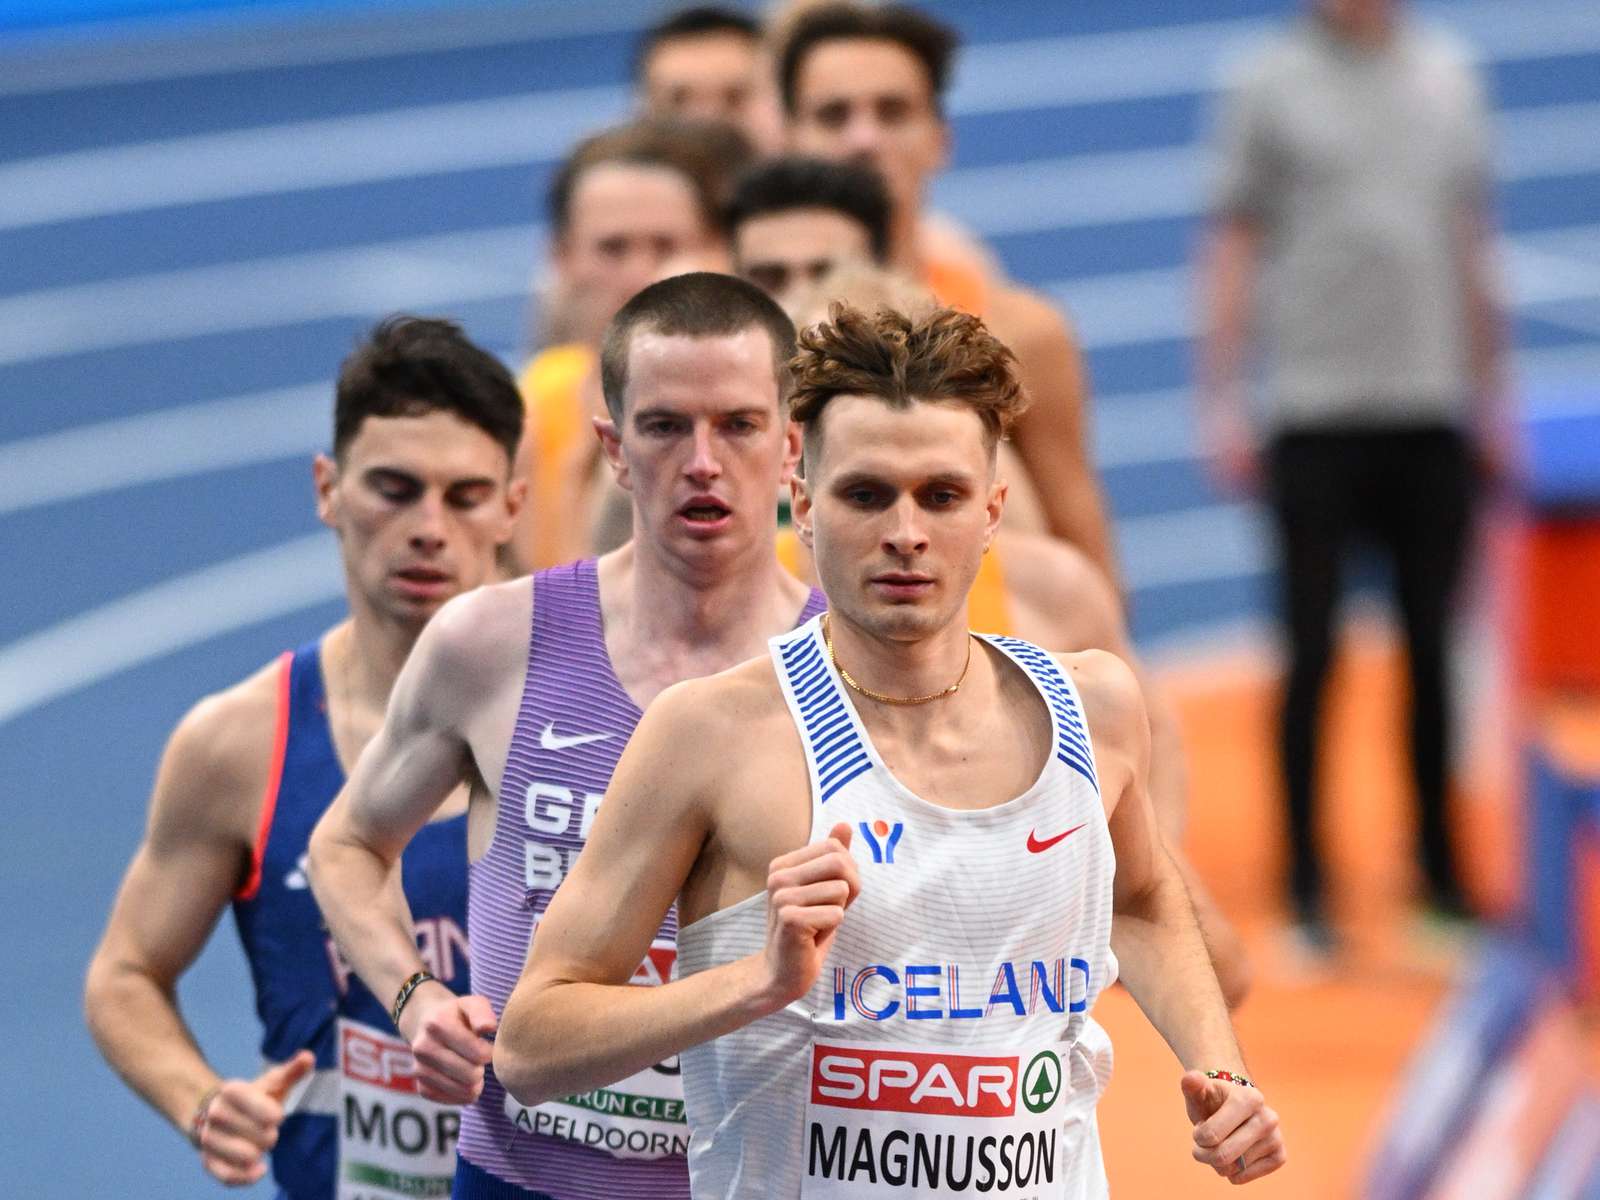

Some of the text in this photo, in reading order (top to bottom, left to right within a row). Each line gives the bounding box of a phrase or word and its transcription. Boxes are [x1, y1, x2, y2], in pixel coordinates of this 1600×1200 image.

[833, 957, 1090, 1021] ICELAND
[818, 1055, 1013, 1108] SPAR
[515, 1108, 690, 1155] APELDOORN
[808, 1122, 1056, 1192] MAGNUSSON
